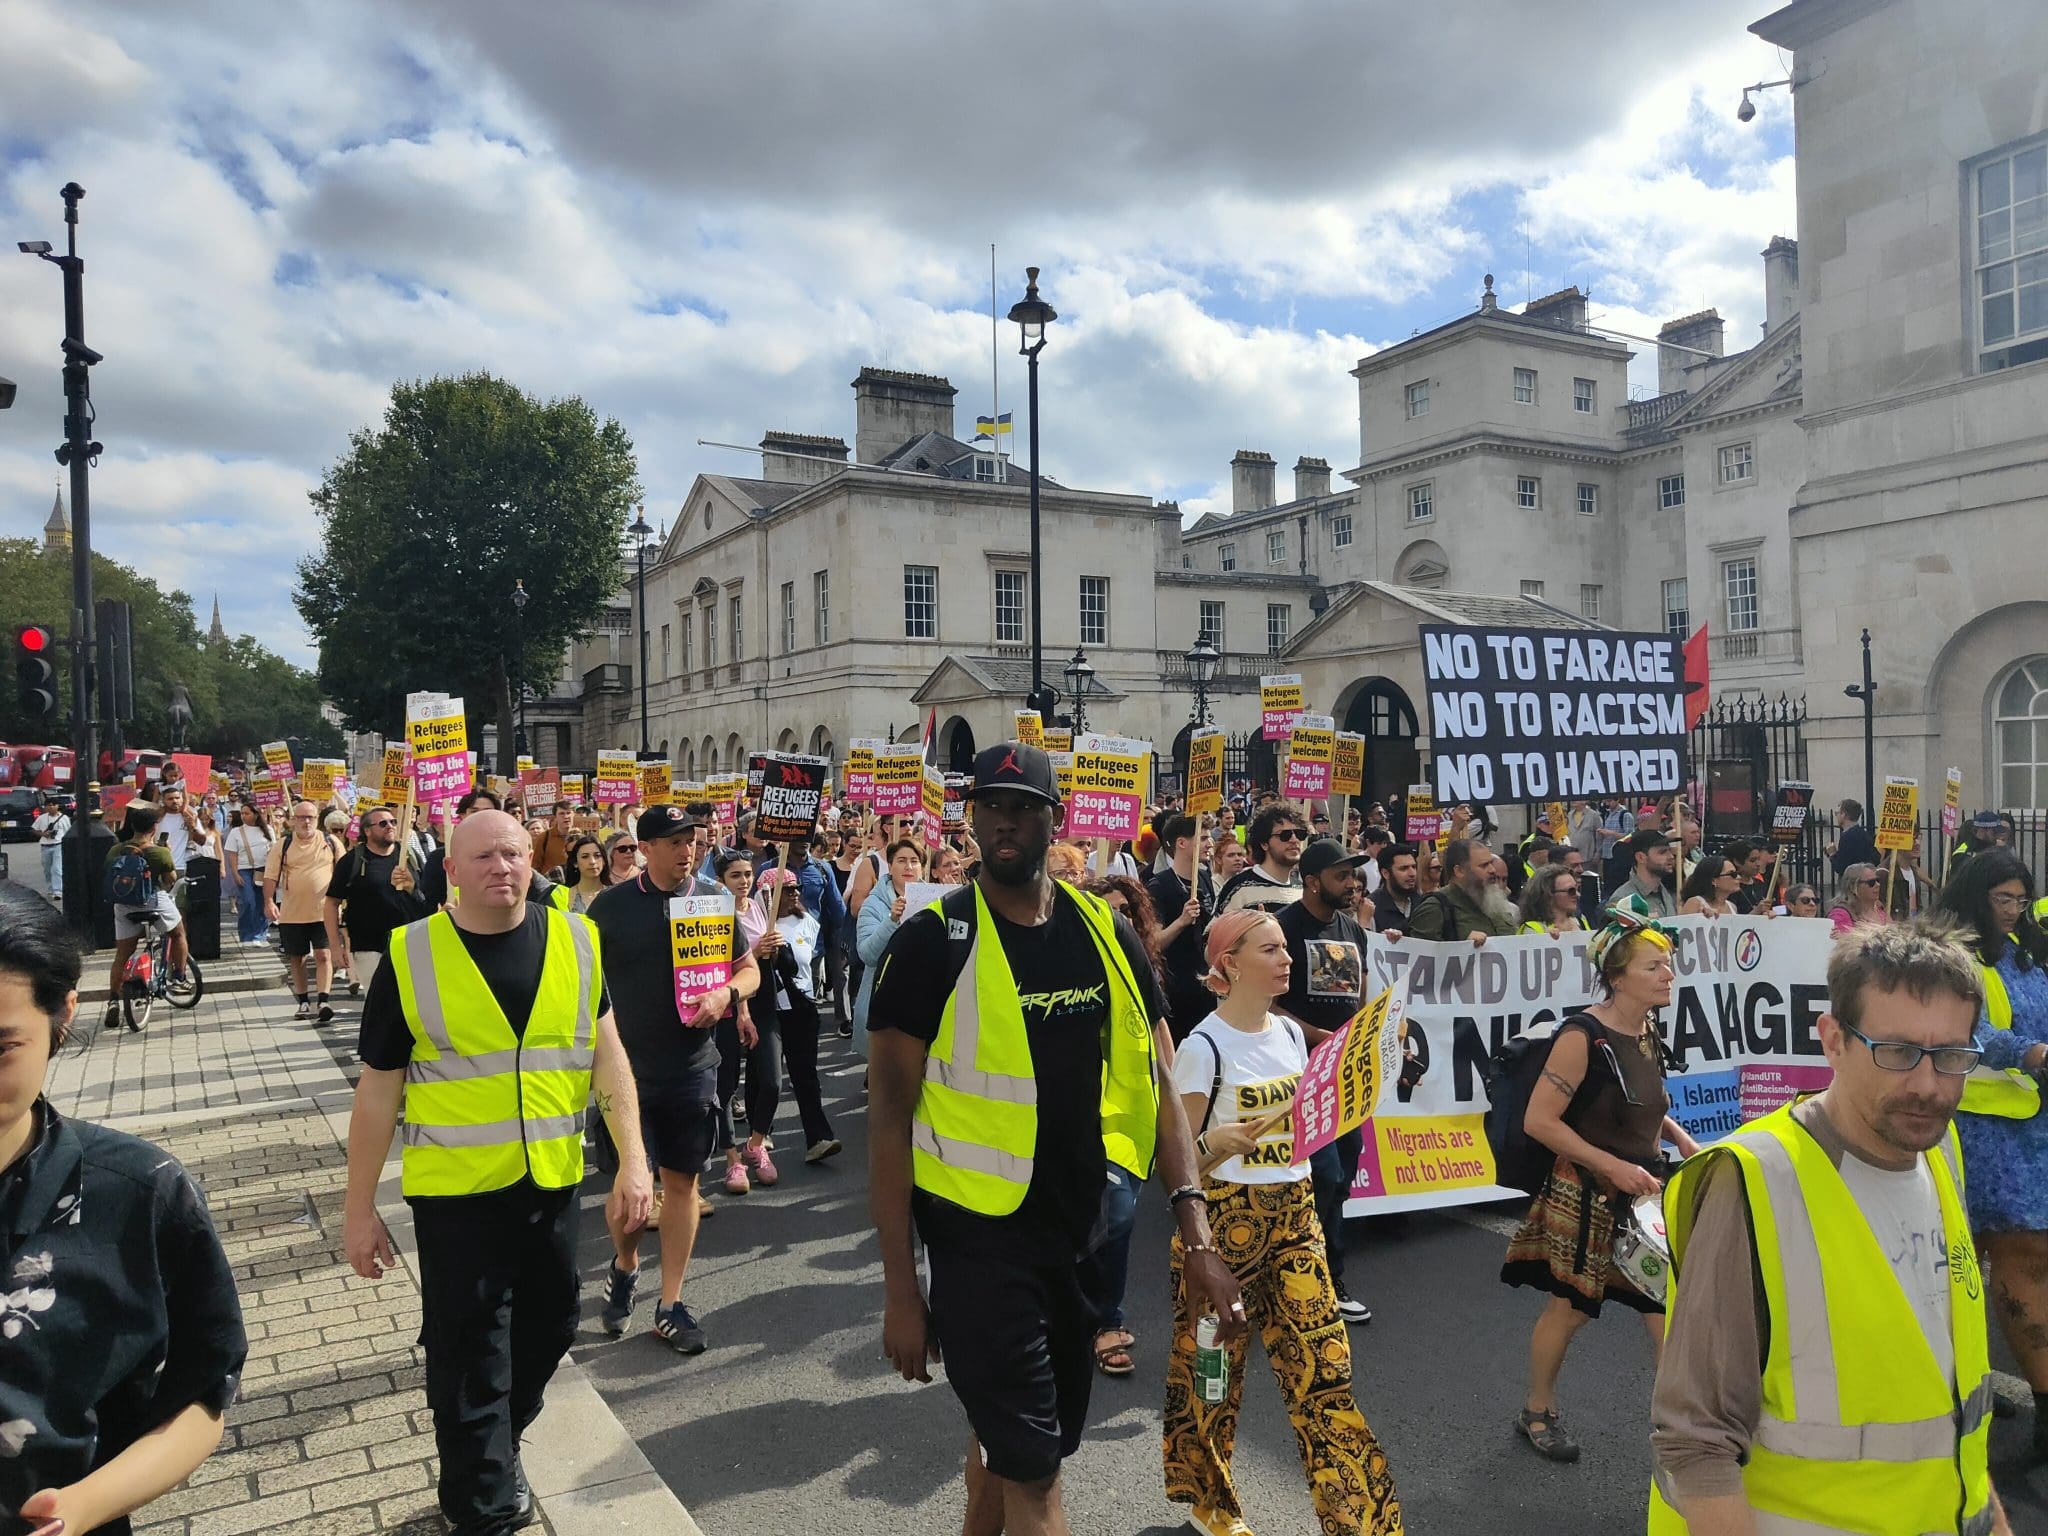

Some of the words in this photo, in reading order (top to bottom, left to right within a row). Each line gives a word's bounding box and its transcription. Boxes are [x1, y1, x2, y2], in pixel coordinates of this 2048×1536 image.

[1424, 633, 1480, 680] NO
[1486, 635, 1537, 681] TO
[1543, 637, 1675, 683] FARAGE
[1264, 688, 1300, 698] Refugees
[1264, 699, 1299, 708] welcome
[1264, 712, 1284, 722] Stop
[1431, 691, 1488, 739] NO
[1495, 691, 1542, 738] TO
[1549, 692, 1686, 737] RACISM
[414, 722, 463, 737] Refugees
[1265, 723, 1278, 732] far
[416, 737, 463, 754] welcome
[1294, 731, 1331, 746] Refugees
[1336, 740, 1357, 751] SMASH
[851, 751, 874, 760] Refug
[1292, 746, 1328, 757] welcome
[417, 760, 444, 776] Stop
[446, 756, 464, 769] the
[600, 761, 634, 769] Refugees
[876, 759, 920, 770] Refugees
[1077, 755, 1138, 774] Refugees
[1334, 753, 1360, 765] FASCISM
[600, 769, 633, 777] welcome
[749, 769, 764, 778] REFU
[876, 770, 918, 780] welcome
[1290, 762, 1310, 778] Stop
[1311, 764, 1326, 776] the
[1332, 767, 1338, 777] &
[1340, 767, 1361, 779] RACISM
[1436, 753, 1495, 802] NO
[1501, 752, 1549, 799] TO
[1555, 748, 1680, 796] HATRED
[384, 776, 391, 786] &
[393, 777, 410, 789] RAC
[418, 778, 437, 792] far
[438, 772, 465, 789] right
[599, 780, 616, 790] Stop
[617, 780, 631, 789] the
[749, 778, 764, 786] WELC
[850, 775, 867, 784] Stop
[1076, 773, 1134, 789] welcome
[1289, 777, 1302, 789] far
[1303, 778, 1324, 792] right
[525, 783, 556, 795] REFUGEES
[599, 789, 609, 798] far
[611, 789, 631, 798] right
[673, 790, 703, 799] Refugees
[708, 784, 734, 793] Refugees
[763, 785, 819, 805] REFUGEES
[849, 785, 862, 794] far
[876, 786, 899, 797] Stop
[902, 785, 917, 794] the
[1886, 786, 1910, 799] SMASH
[527, 793, 557, 806] WELCOME
[721, 802, 731, 810] the
[876, 798, 891, 807] far
[893, 796, 916, 808] right
[1074, 794, 1107, 811] Stop
[1110, 796, 1131, 811] the
[761, 800, 817, 820] WELCOME
[1774, 805, 1807, 818] REFUGEES
[1883, 801, 1912, 815] FASCISM
[764, 816, 779, 826] Open
[1073, 811, 1095, 825] far
[1098, 812, 1130, 830] right
[1408, 817, 1425, 826] Stop
[1426, 816, 1437, 825] the
[1772, 816, 1804, 828] WELCOME
[1880, 817, 1887, 829] &
[1887, 817, 1914, 831] RACISM
[763, 824, 771, 832] No
[1408, 826, 1418, 835] far
[1420, 826, 1436, 835] right
[675, 921, 731, 939] Refugees
[678, 941, 727, 959] welcome
[679, 969, 713, 988] Stop
[1373, 948, 1508, 1005] STAND
[1519, 947, 1563, 1001] UP
[1573, 944, 1593, 994] T
[1386, 1019, 1399, 1056] STAND
[1311, 1039, 1332, 1073] far
[1319, 1026, 1349, 1084] Stop
[1360, 996, 1388, 1118] Refugees
[1380, 1038, 1389, 1082] RACISM
[1342, 1010, 1368, 1123] welcome
[1389, 1057, 1397, 1071] UP
[1240, 1076, 1301, 1108] STAN
[1302, 1078, 1319, 1145] right
[1320, 1085, 1336, 1135] the
[1386, 1127, 1448, 1157] Migrants
[1449, 1130, 1474, 1148] are
[1395, 1160, 1420, 1184] not
[1420, 1159, 1437, 1182] to
[1436, 1156, 1485, 1181] blame
[1951, 1245, 1965, 1284] STAND
